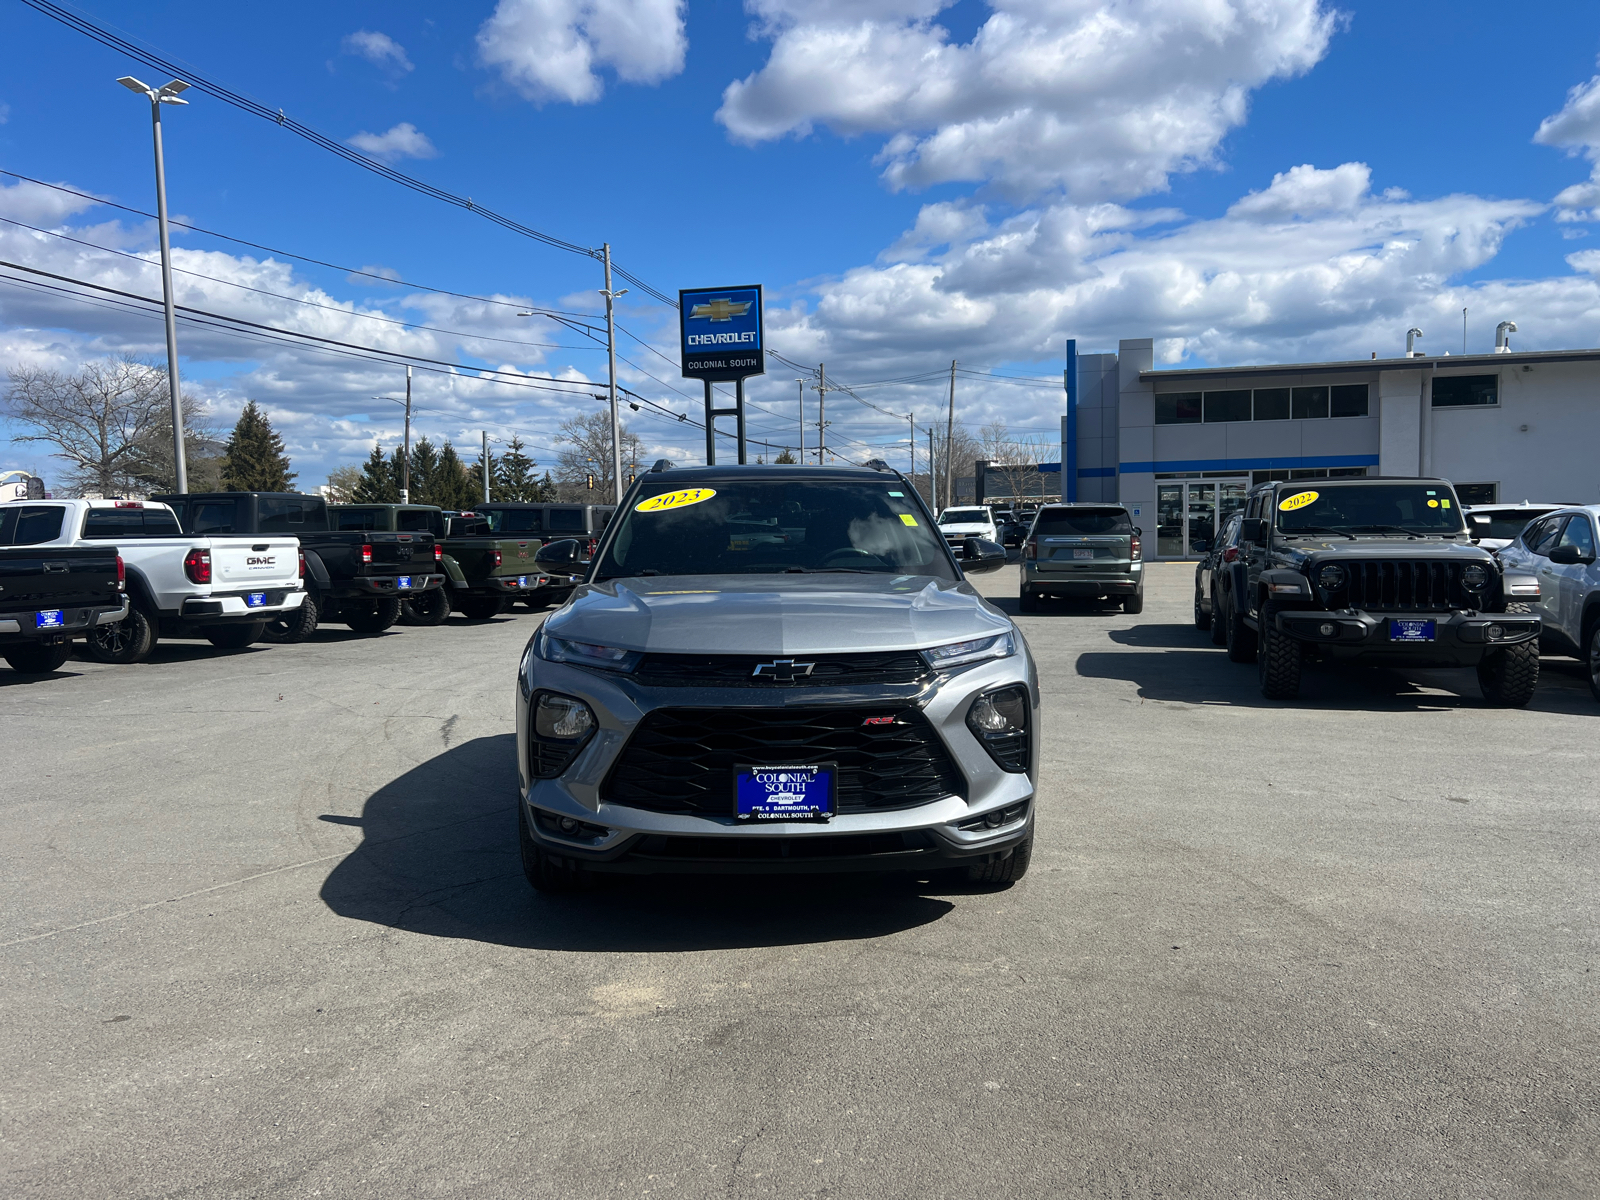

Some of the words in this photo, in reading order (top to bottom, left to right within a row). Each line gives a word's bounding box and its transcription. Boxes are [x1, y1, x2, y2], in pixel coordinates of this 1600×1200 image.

[688, 331, 756, 345] CHEVROLET
[688, 360, 728, 369] COLONIAL
[729, 358, 757, 367] SOUTH
[649, 490, 701, 510] 2023
[1288, 493, 1312, 509] 2022
[397, 546, 414, 556] Jeep
[247, 557, 276, 565] GMC
[862, 717, 894, 726] RS
[756, 773, 815, 783] COLONIAL
[765, 782, 806, 792] SOUTH
